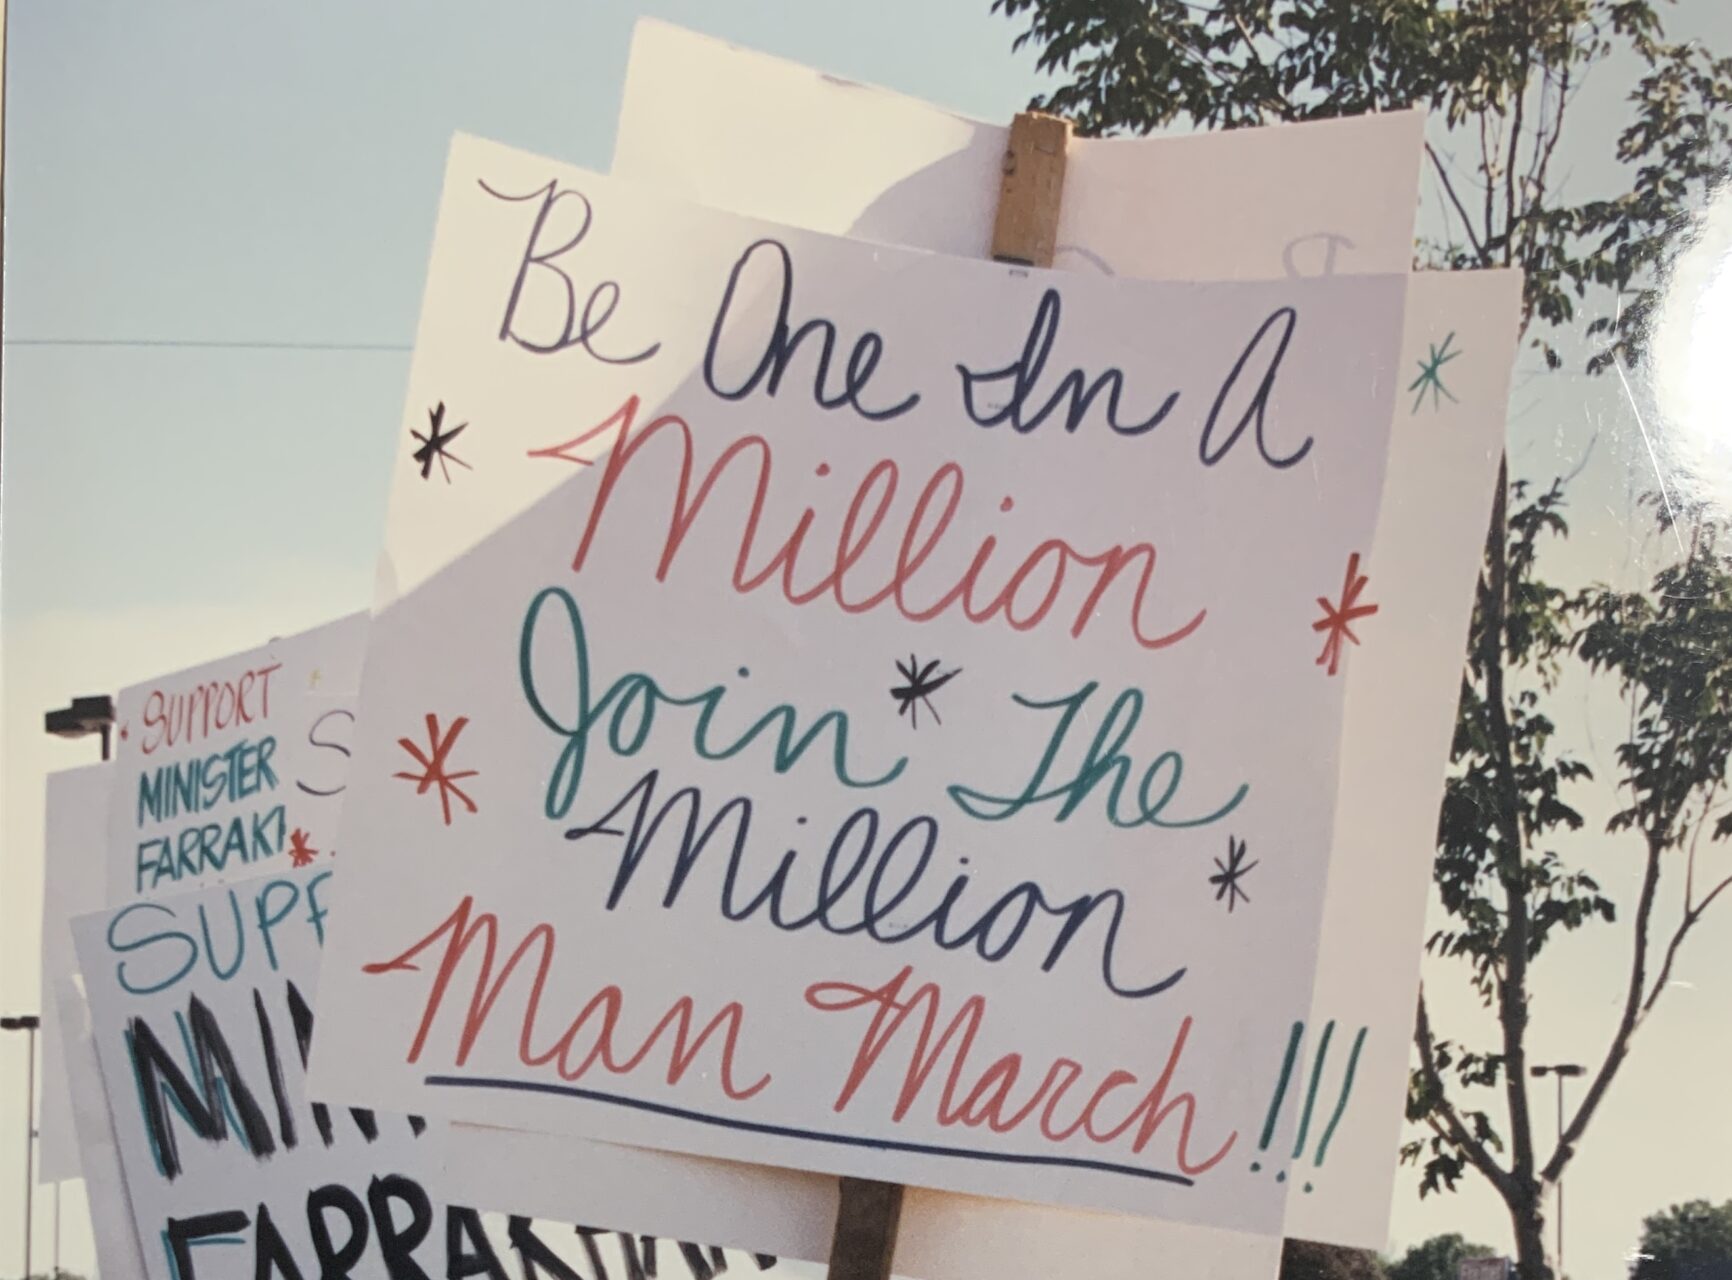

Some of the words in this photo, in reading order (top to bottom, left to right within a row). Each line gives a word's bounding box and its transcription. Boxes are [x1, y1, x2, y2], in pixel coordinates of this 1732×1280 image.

[476, 179, 661, 364] Be
[702, 238, 922, 421] One
[955, 288, 1181, 435] In
[1198, 306, 1314, 468] A
[526, 394, 1208, 650] Million
[136, 735, 280, 830] MINISTER
[141, 662, 283, 755] SUPPORT
[518, 585, 910, 819] Join
[947, 680, 1250, 829] The
[563, 769, 1188, 997] Million
[361, 895, 772, 1101] Man
